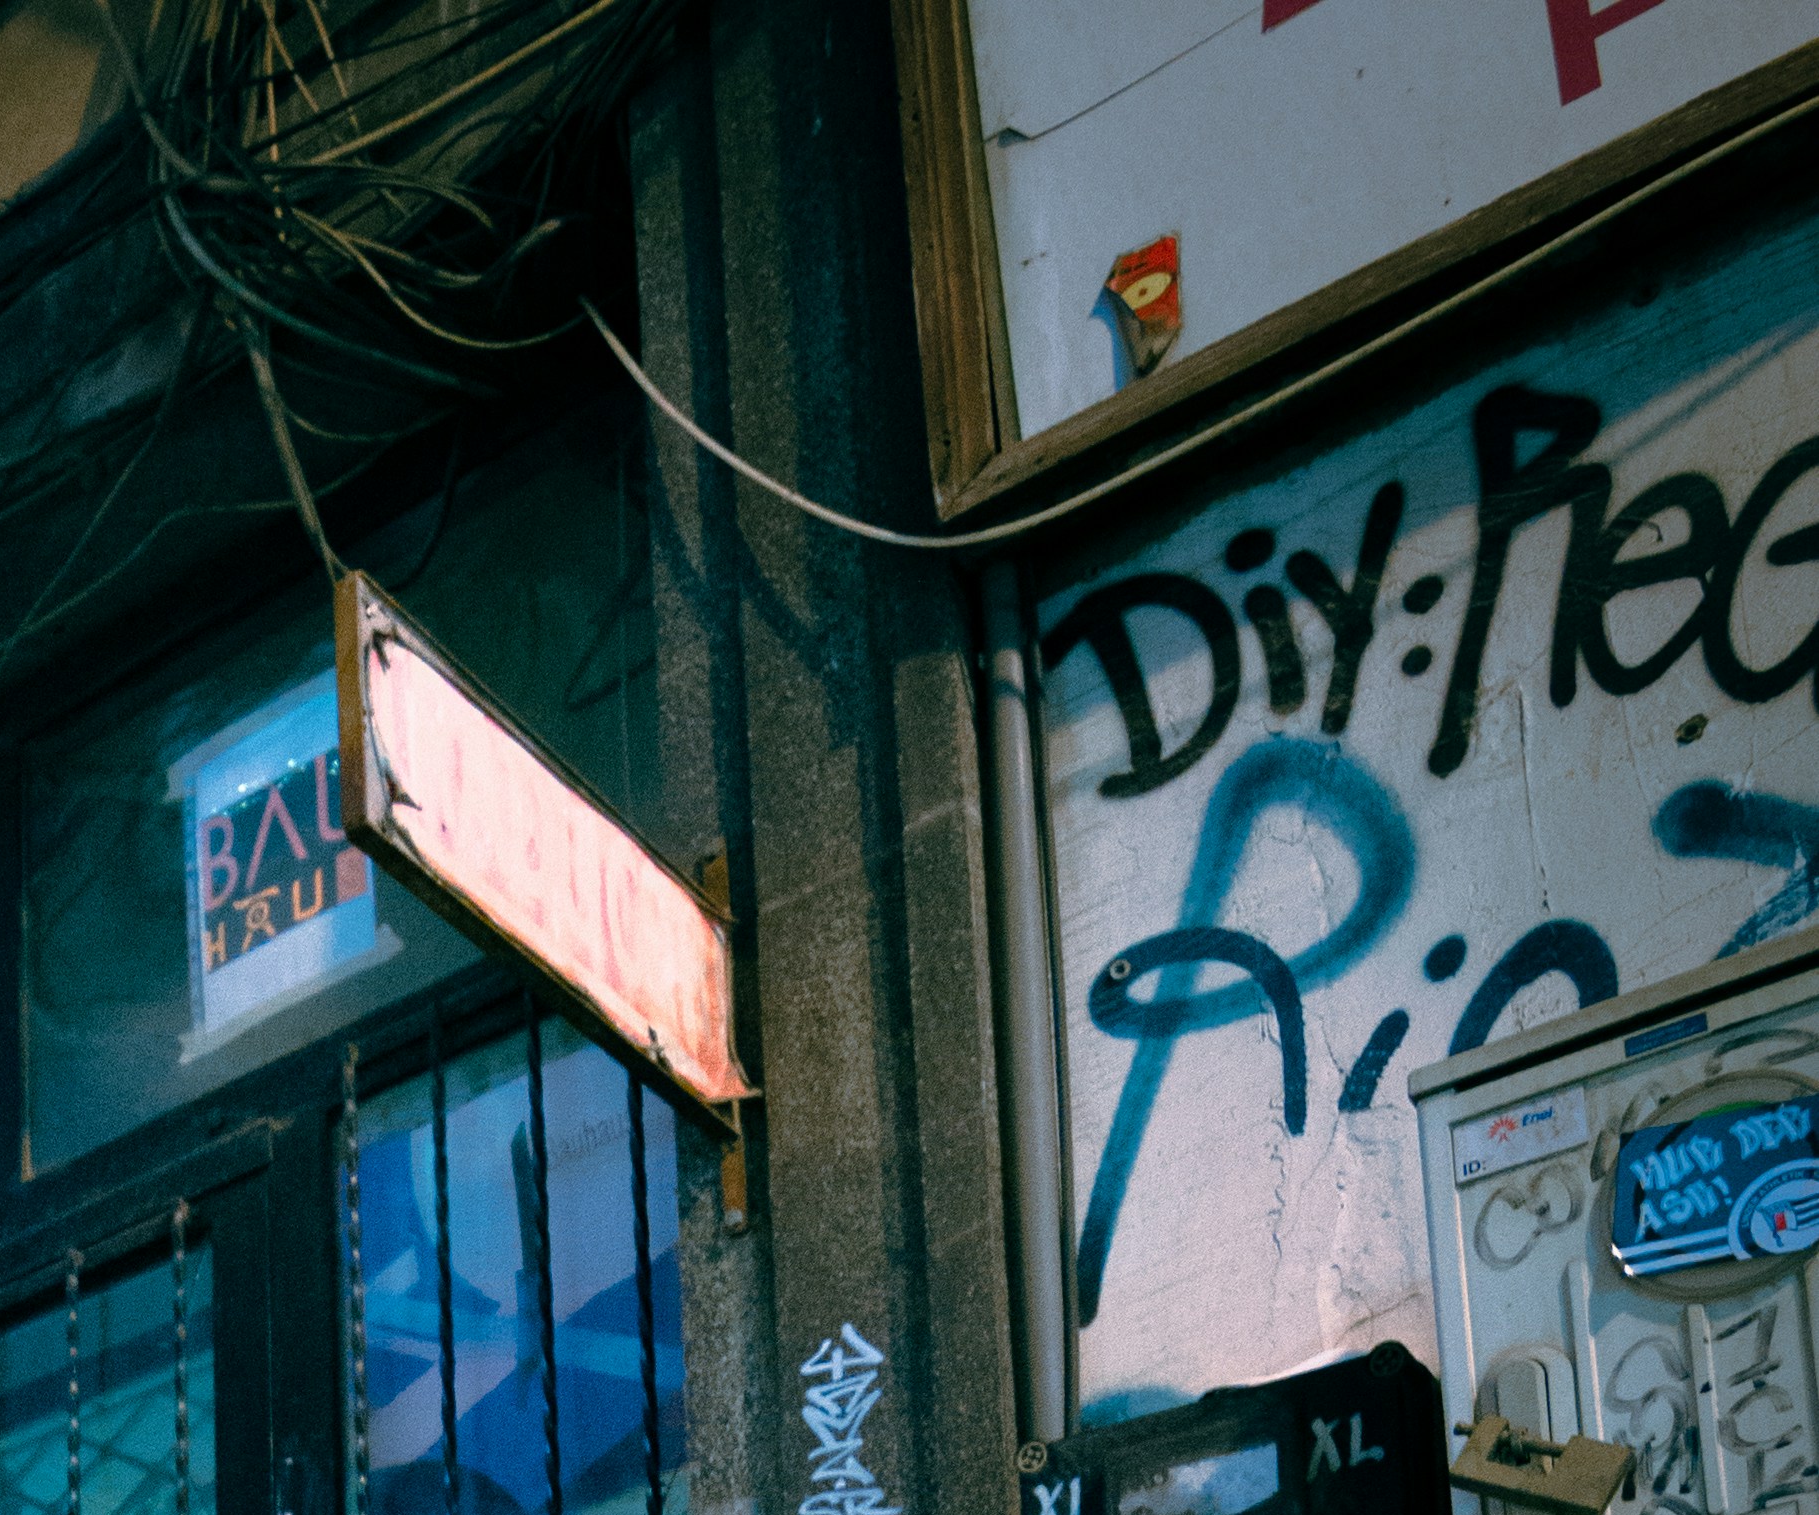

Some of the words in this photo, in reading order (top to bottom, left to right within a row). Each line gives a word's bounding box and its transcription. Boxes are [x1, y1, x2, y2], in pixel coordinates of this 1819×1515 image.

[1522, 1106, 1552, 1126] Enel
[1463, 1160, 1486, 1176] ID:
[1306, 1412, 1385, 1483] XL
